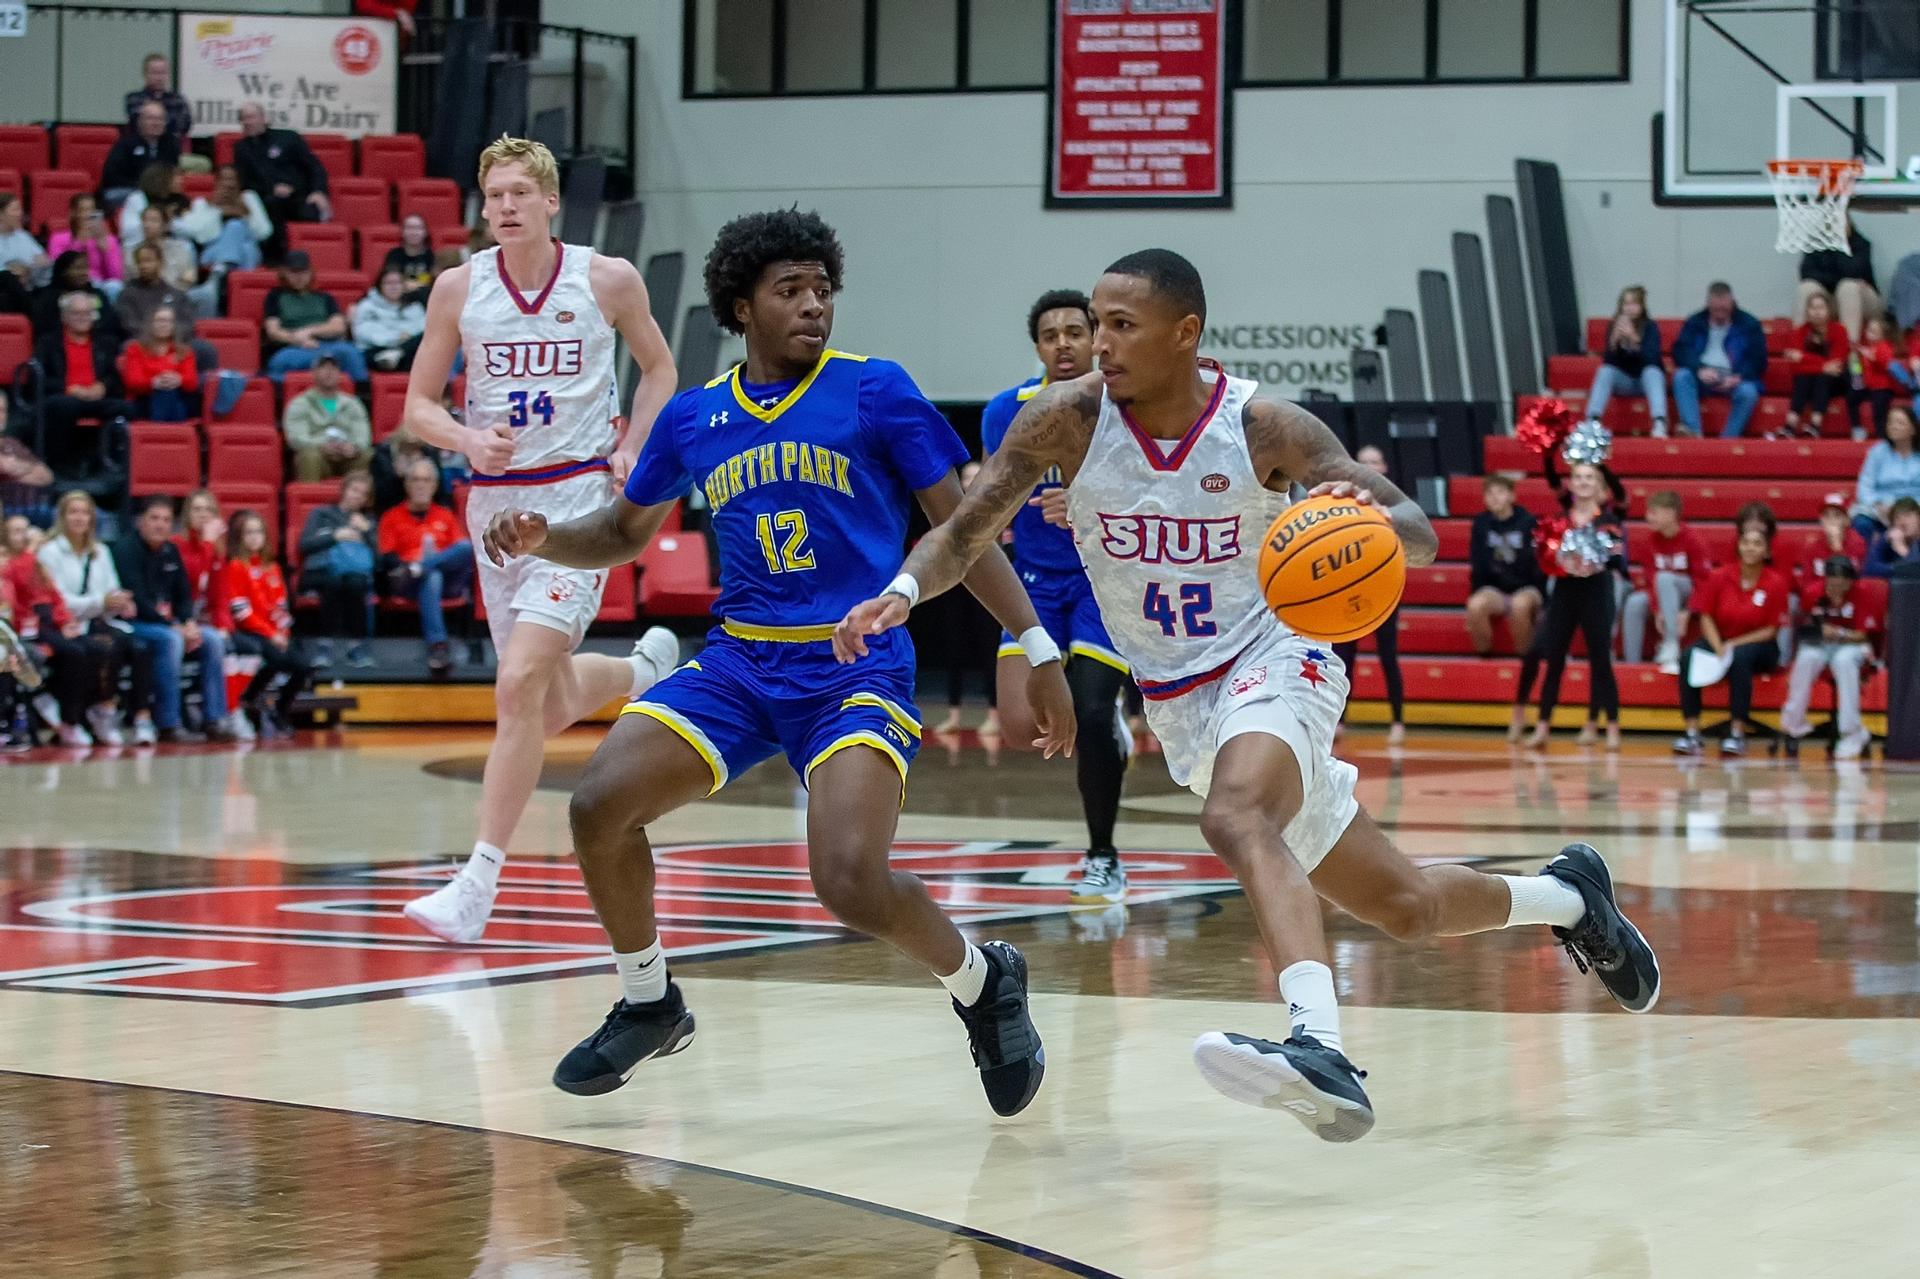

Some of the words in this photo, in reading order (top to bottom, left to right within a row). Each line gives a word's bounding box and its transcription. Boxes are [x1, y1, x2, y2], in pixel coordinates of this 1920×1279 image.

[237, 73, 284, 99] We
[291, 76, 340, 100] Are
[192, 100, 297, 125] Illinis'
[305, 103, 380, 130] Dairy
[1200, 325, 1365, 350] NCESSIONS
[482, 339, 582, 377] SIUE
[1228, 361, 1349, 385] TROOMS
[507, 390, 555, 428] 34
[704, 443, 779, 518] NORTH
[780, 441, 855, 498] PARK
[756, 508, 817, 575] 12
[1096, 512, 1242, 565] SIUE
[1269, 505, 1362, 553] Wilson
[1311, 541, 1363, 582] EVO
[1143, 581, 1218, 638] 42
